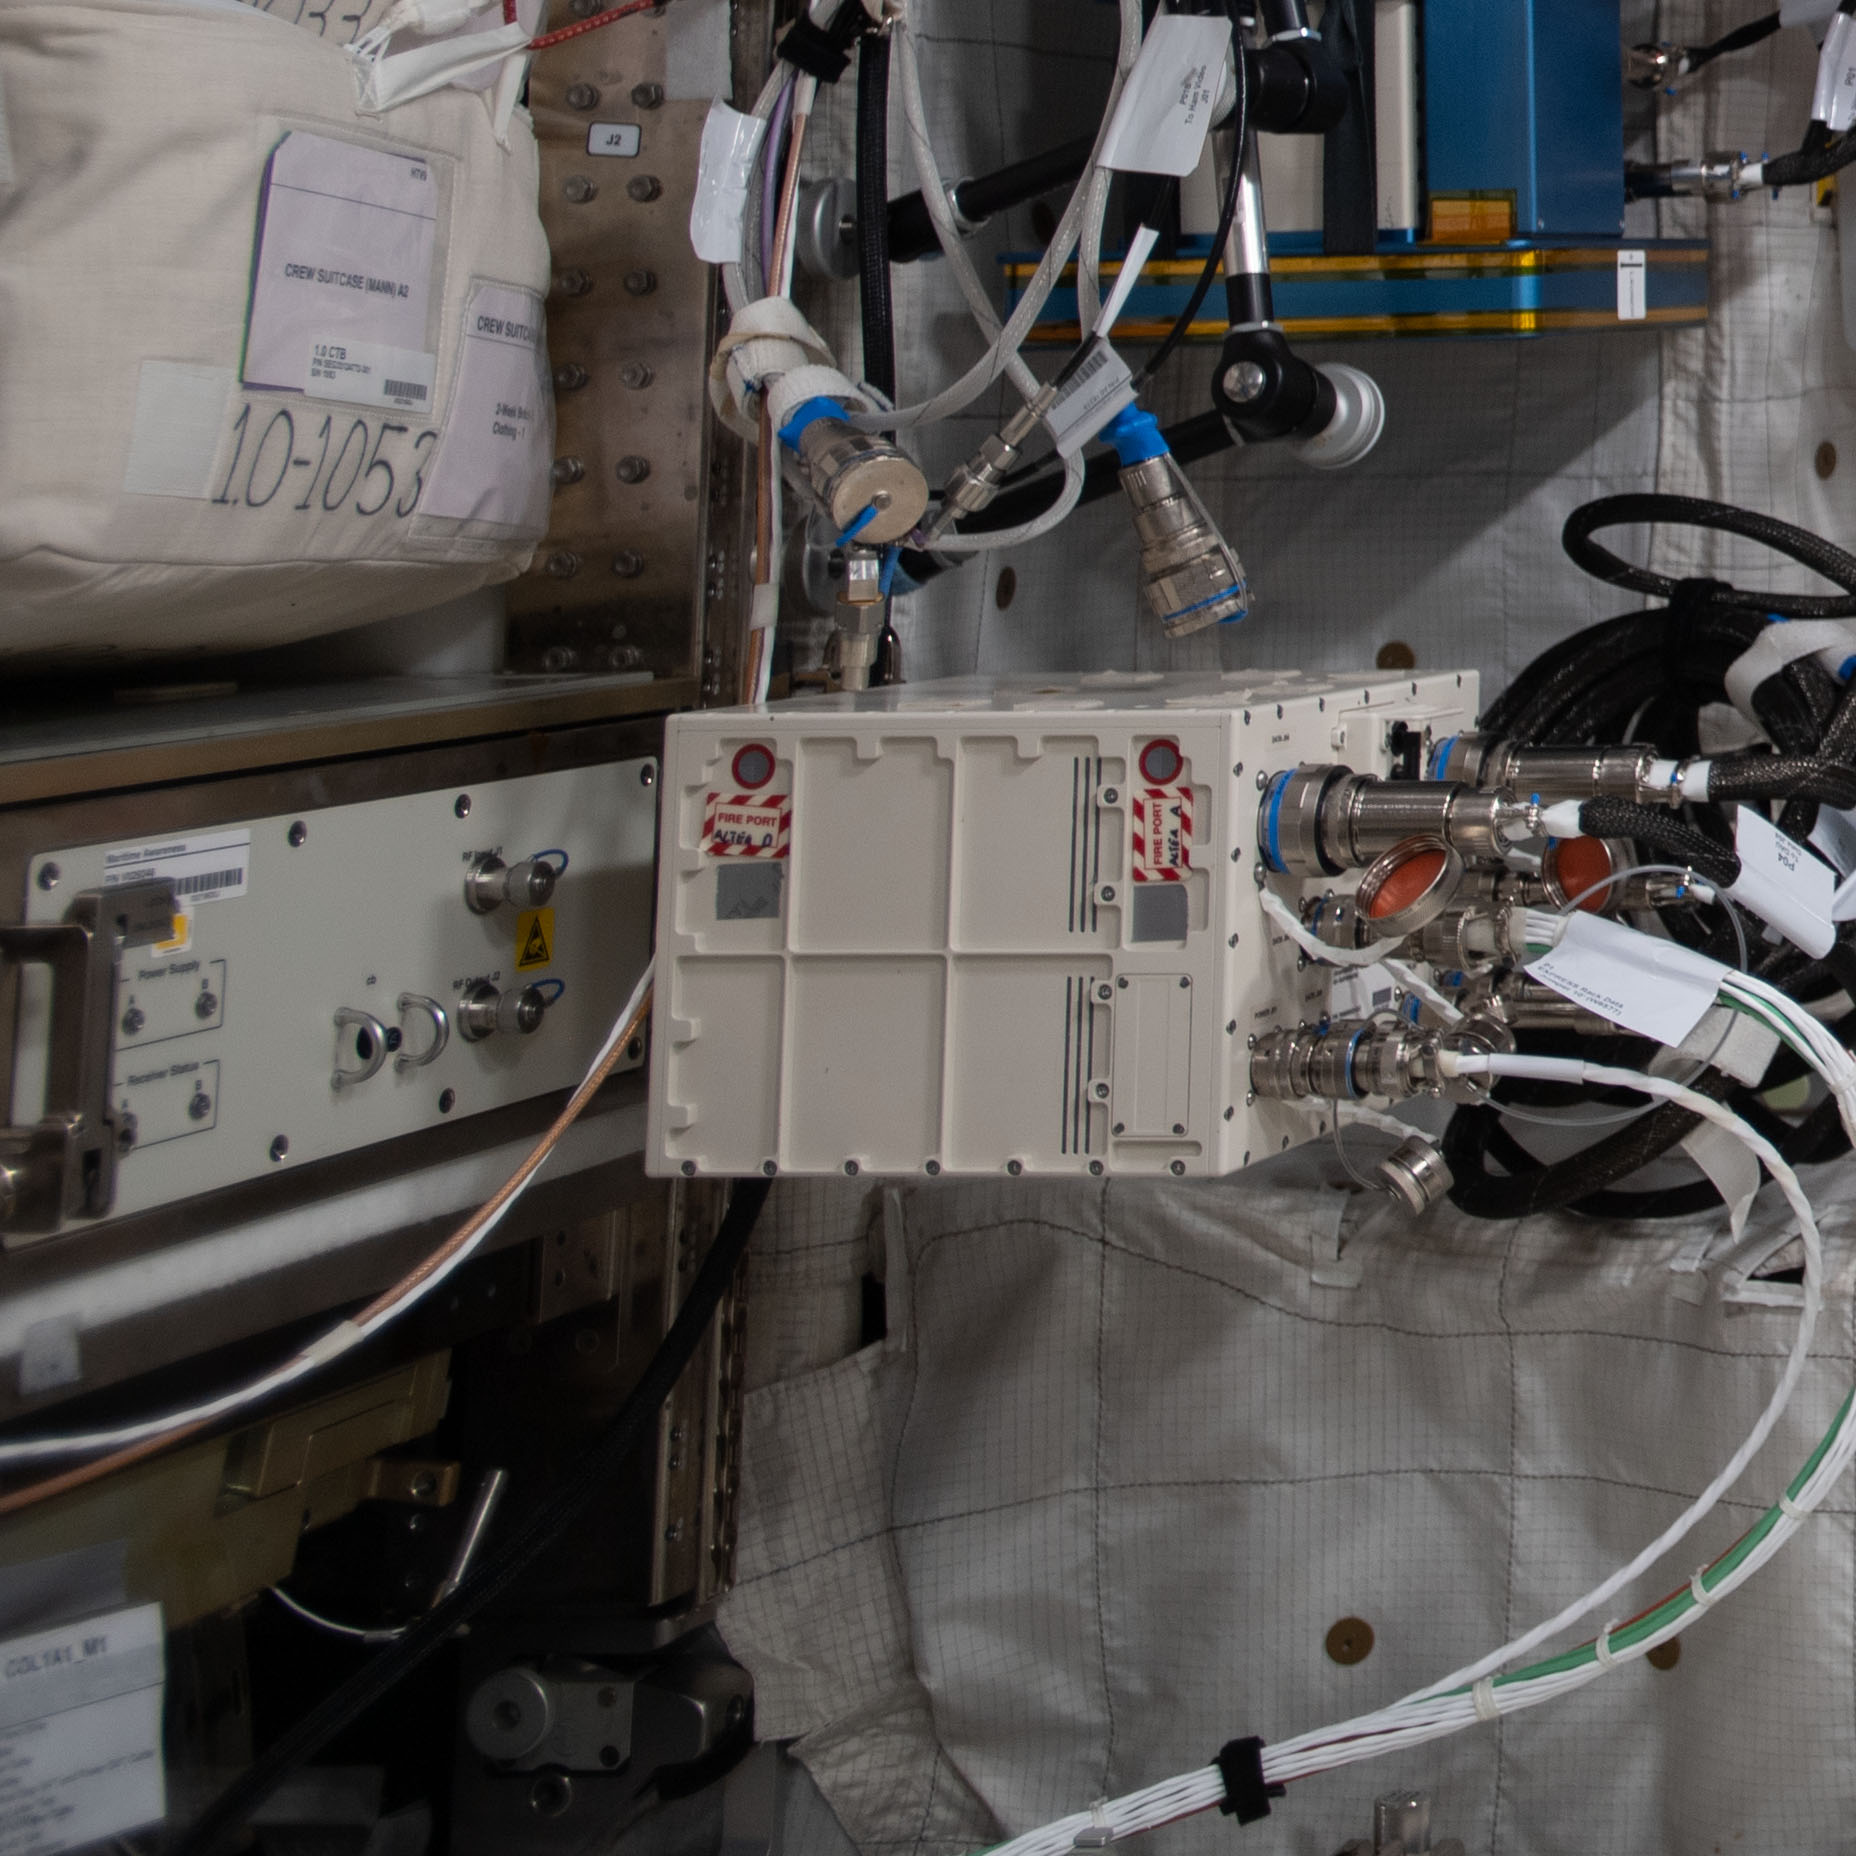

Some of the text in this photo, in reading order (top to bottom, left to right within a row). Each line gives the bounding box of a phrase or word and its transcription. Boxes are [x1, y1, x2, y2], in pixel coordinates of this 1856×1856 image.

[1845, 66, 1856, 86] P01
[604, 134, 622, 146] J2
[284, 263, 316, 281] CREW
[316, 268, 364, 291] SUITCASE
[364, 276, 398, 298] (MANN)
[476, 316, 504, 336] CREW
[328, 346, 346, 360] CTB
[718, 811, 777, 831] FIRE PORT
[1168, 806, 1182, 819] A
[1152, 802, 1163, 864] FIRE PORT
[1778, 854, 1796, 872] P04
[138, 960, 200, 982] Power Supply
[1537, 965, 1624, 1009] EXPRESS Rack Data
[127, 1060, 200, 1087] Receiver Status
